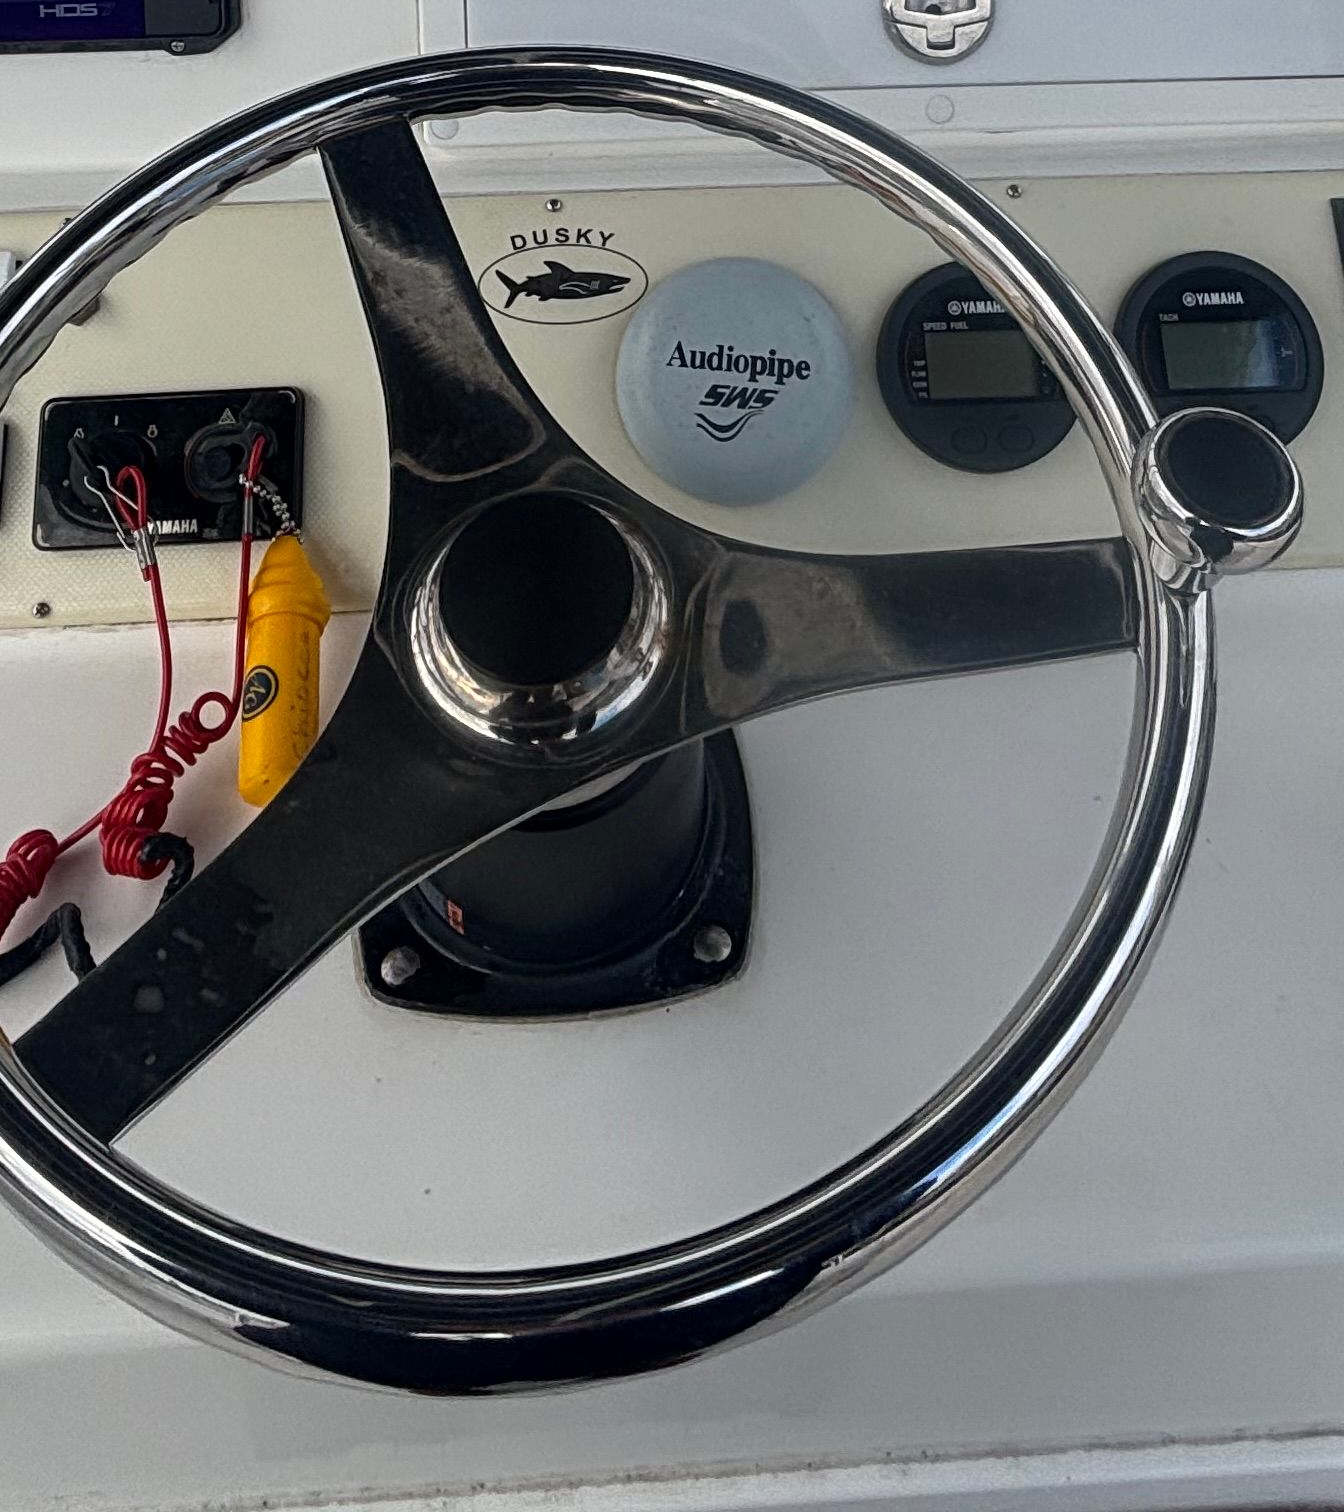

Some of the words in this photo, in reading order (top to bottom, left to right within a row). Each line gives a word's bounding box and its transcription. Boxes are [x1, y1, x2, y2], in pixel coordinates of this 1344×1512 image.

[509, 227, 616, 251] DUSKY
[961, 300, 1005, 314] YAMAH
[1196, 291, 1245, 306] YAMAHA
[922, 321, 948, 331] SPEED
[950, 320, 969, 330] FUEL
[666, 340, 811, 386] Audiopipe
[698, 384, 780, 410] SWS
